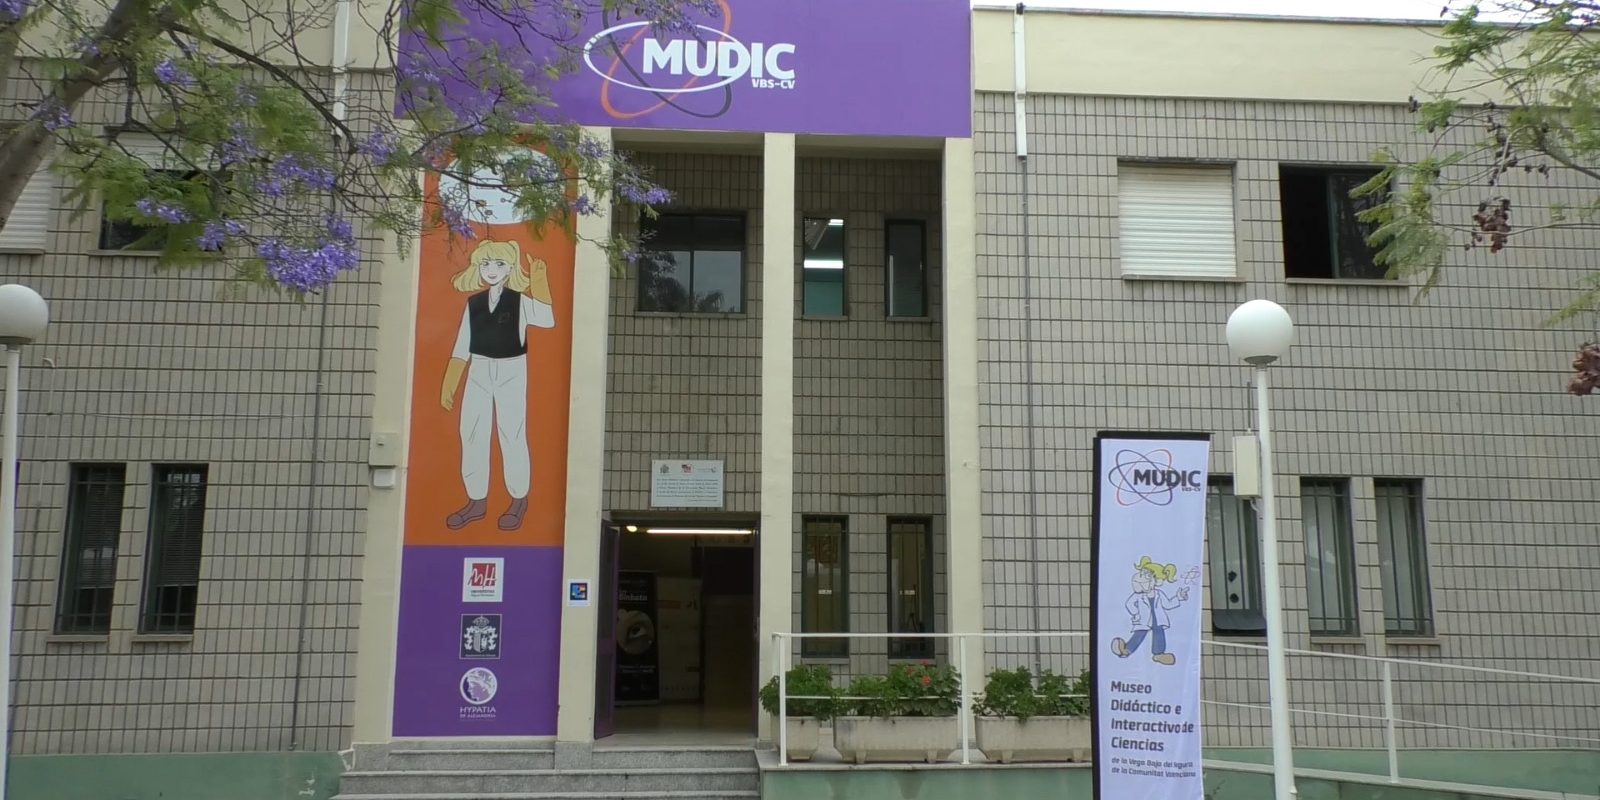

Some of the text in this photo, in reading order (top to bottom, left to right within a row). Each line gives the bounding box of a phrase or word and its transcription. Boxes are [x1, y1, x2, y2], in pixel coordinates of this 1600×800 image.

[642, 38, 796, 80] MUDIC
[751, 78, 796, 89] VBS-CV
[1133, 469, 1202, 487] MUDIC
[1110, 680, 1152, 694] Museo
[1110, 699, 1182, 715] Didáctico e
[1110, 718, 1195, 733] Interactivo de
[1111, 736, 1165, 751] Ciencias
[1128, 758, 1145, 767] Vega
[1146, 759, 1162, 769] Baja
